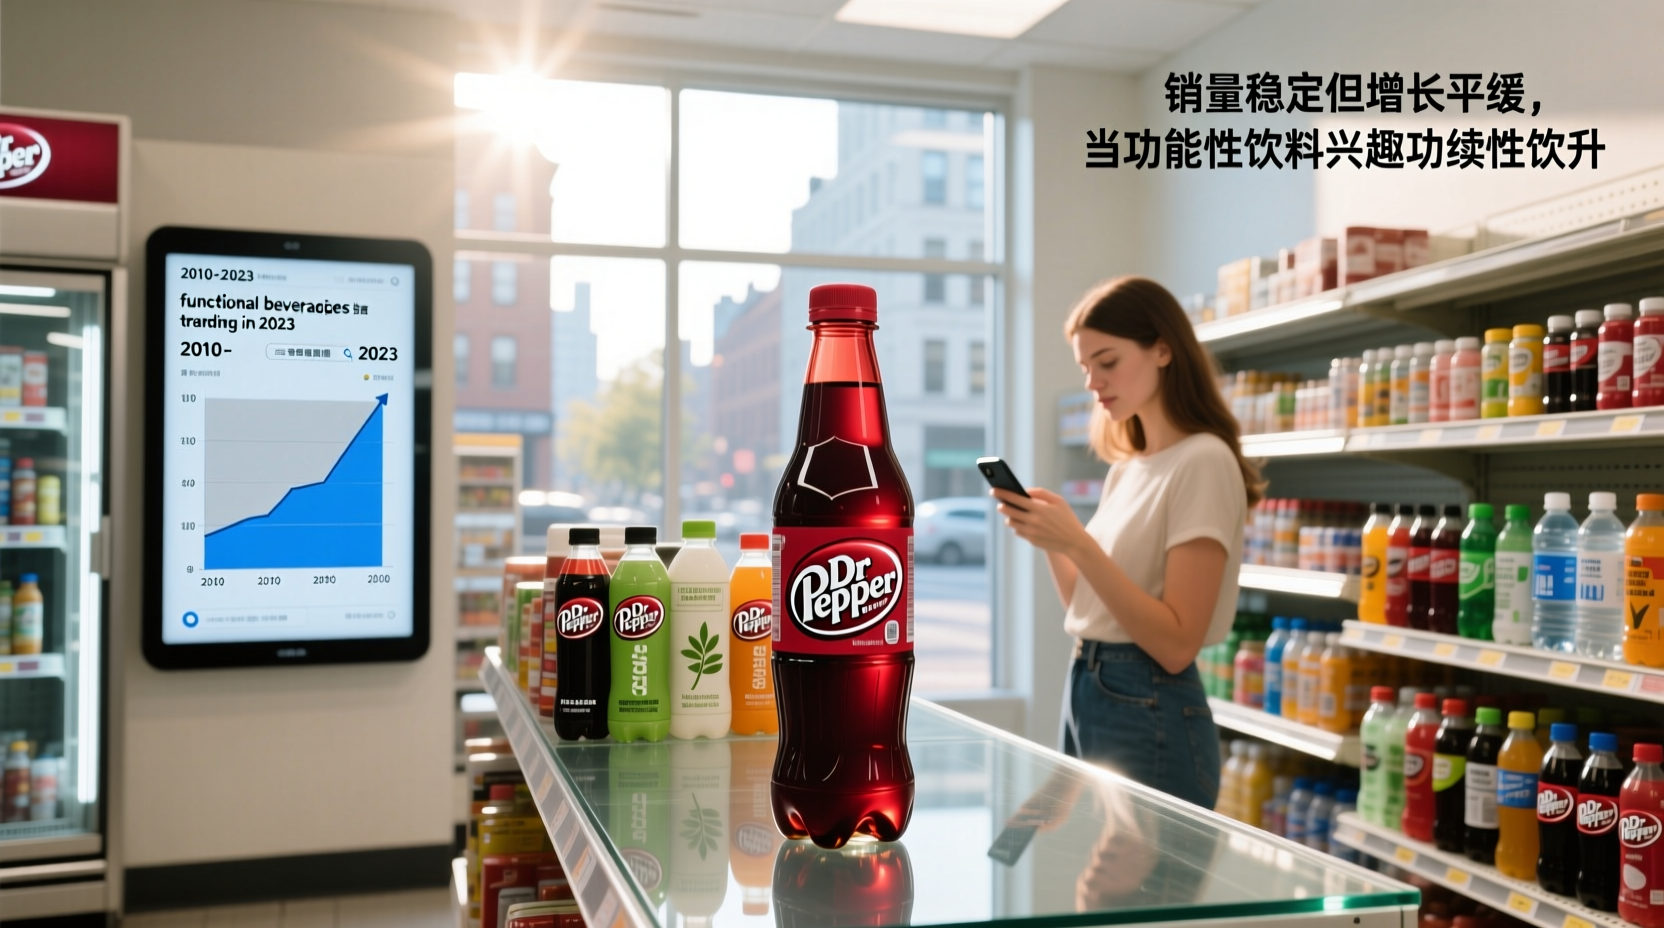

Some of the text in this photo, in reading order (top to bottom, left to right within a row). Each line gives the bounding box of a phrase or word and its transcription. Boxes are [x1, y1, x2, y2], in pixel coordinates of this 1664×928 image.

[181, 267, 253, 281] 2010-2023
[180, 293, 259, 310] functional
[242, 315, 255, 330] in
[259, 316, 295, 331] 2023
[180, 342, 232, 357] 2010-
[358, 346, 398, 361] 2023
[257, 576, 281, 585] 2010
[828, 555, 871, 591] Dr
[200, 577, 225, 586] 2010
[793, 564, 896, 625] Pepper
